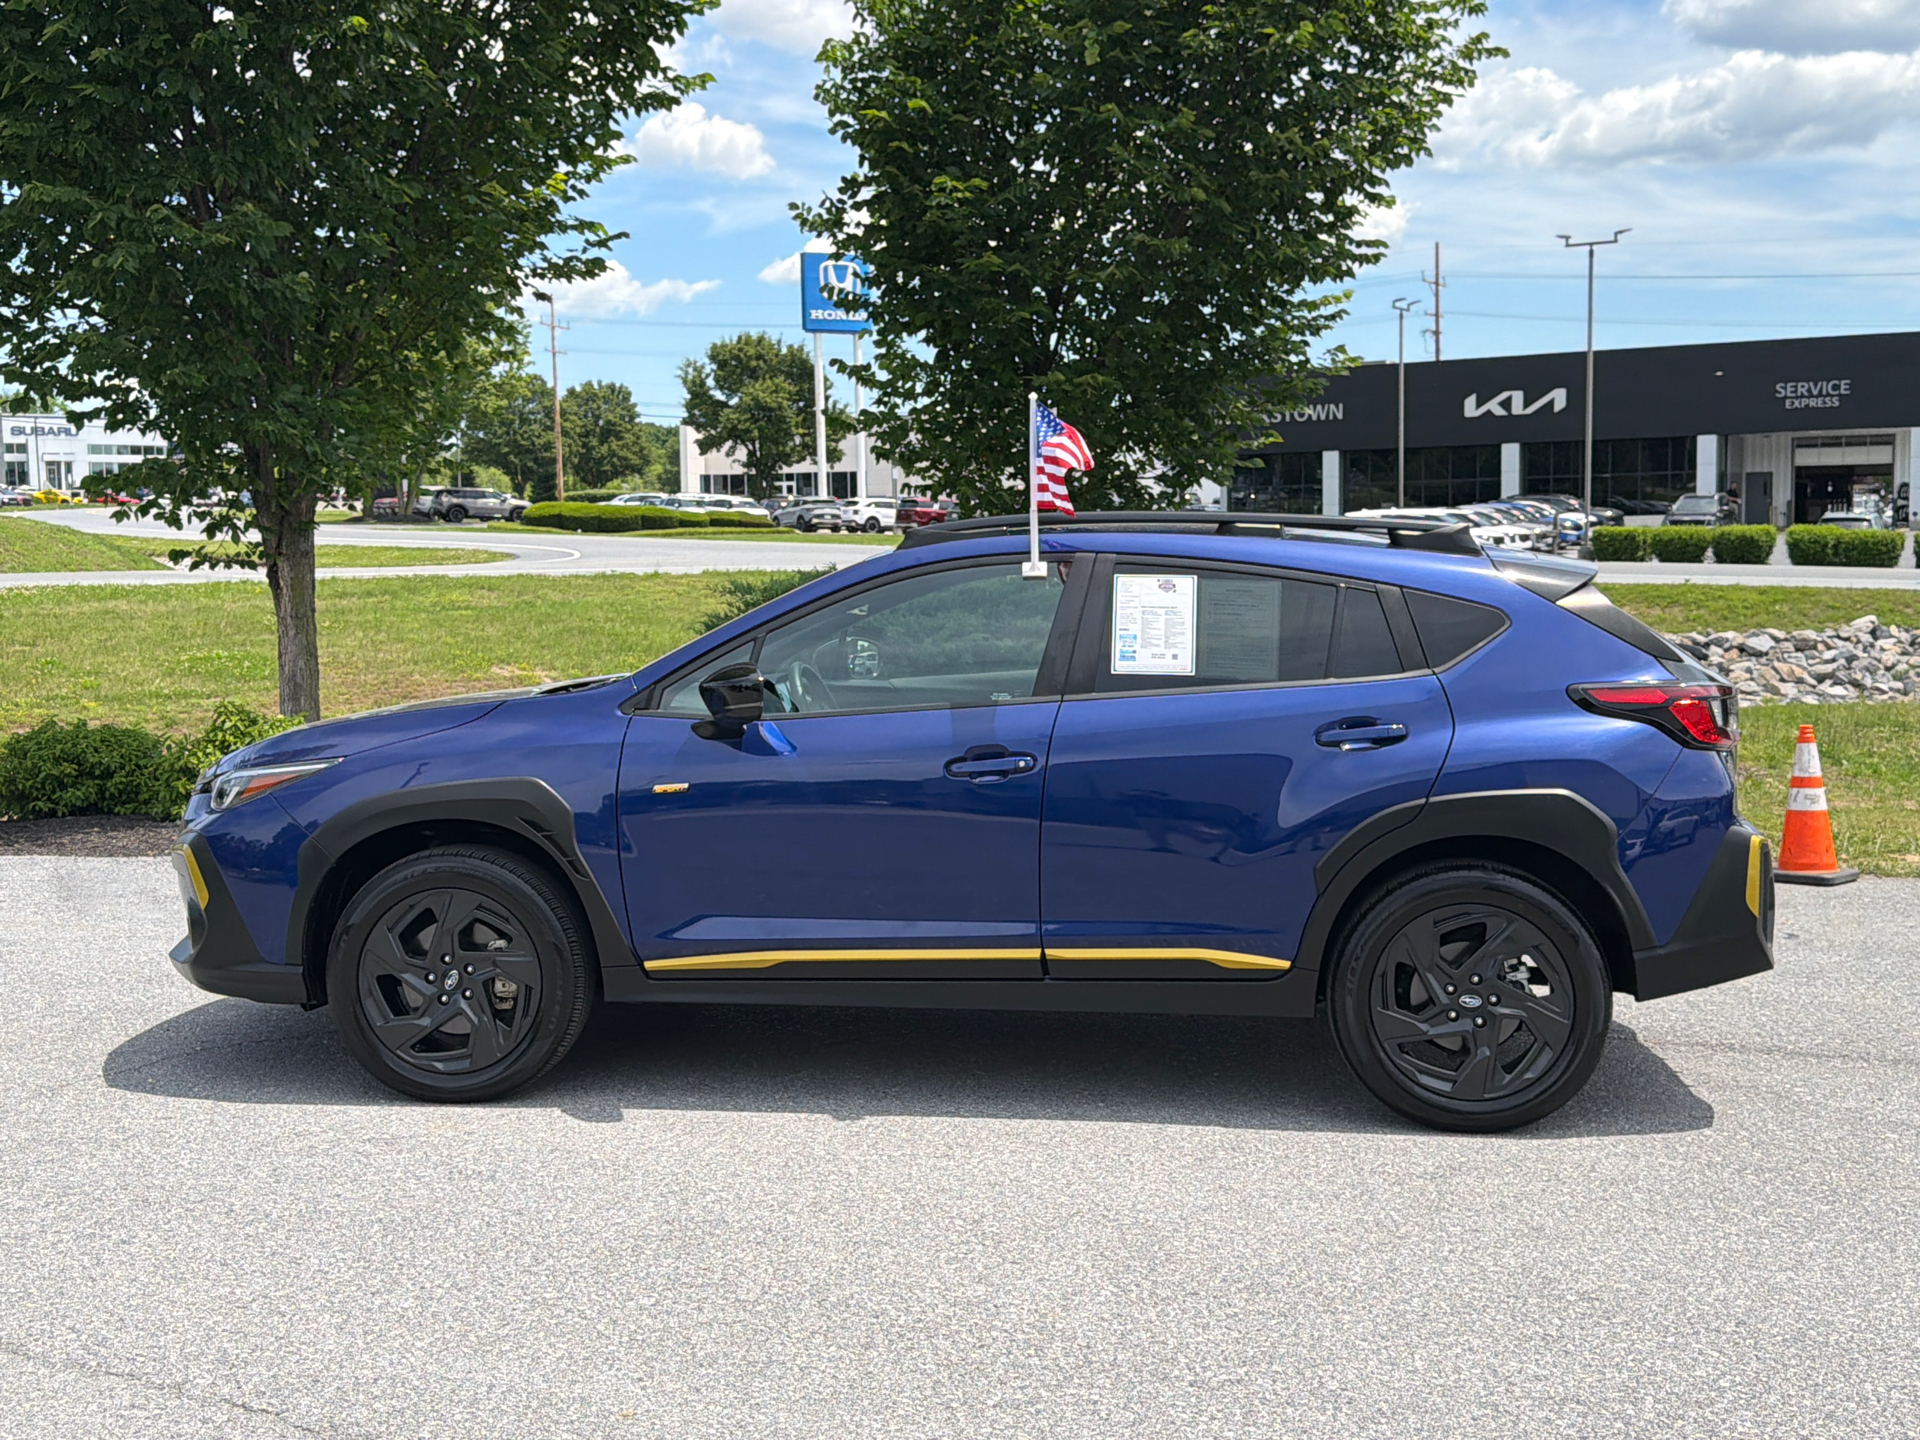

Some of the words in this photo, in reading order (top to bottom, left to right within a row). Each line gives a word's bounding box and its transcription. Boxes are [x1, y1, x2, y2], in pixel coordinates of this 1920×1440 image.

[1775, 379, 1851, 398] SERVICE
[1463, 387, 1567, 418] KIA
[1785, 396, 1840, 409] EXPRESS
[10, 426, 79, 437] SUBARU
